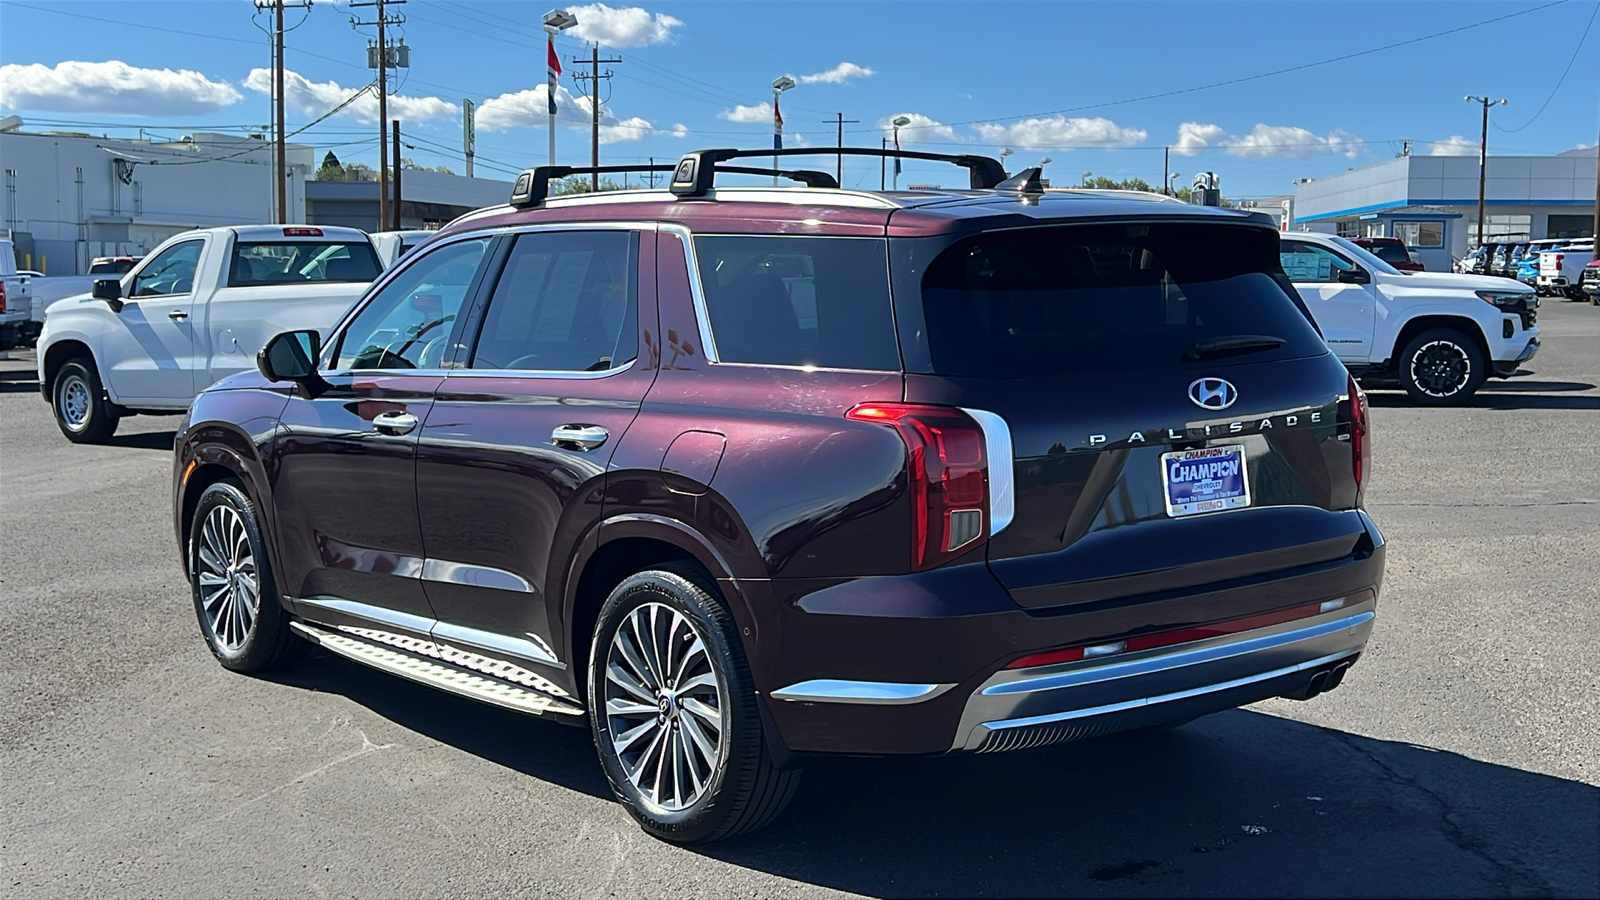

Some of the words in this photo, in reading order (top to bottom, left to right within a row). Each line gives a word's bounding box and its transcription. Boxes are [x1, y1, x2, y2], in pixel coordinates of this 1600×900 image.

[1089, 412, 1321, 446] PALISADE
[1185, 448, 1223, 460] CHAMPION
[1170, 460, 1239, 483] CHAMPION
[1193, 481, 1221, 491] CHEVROLET
[1196, 500, 1223, 511] RENO
